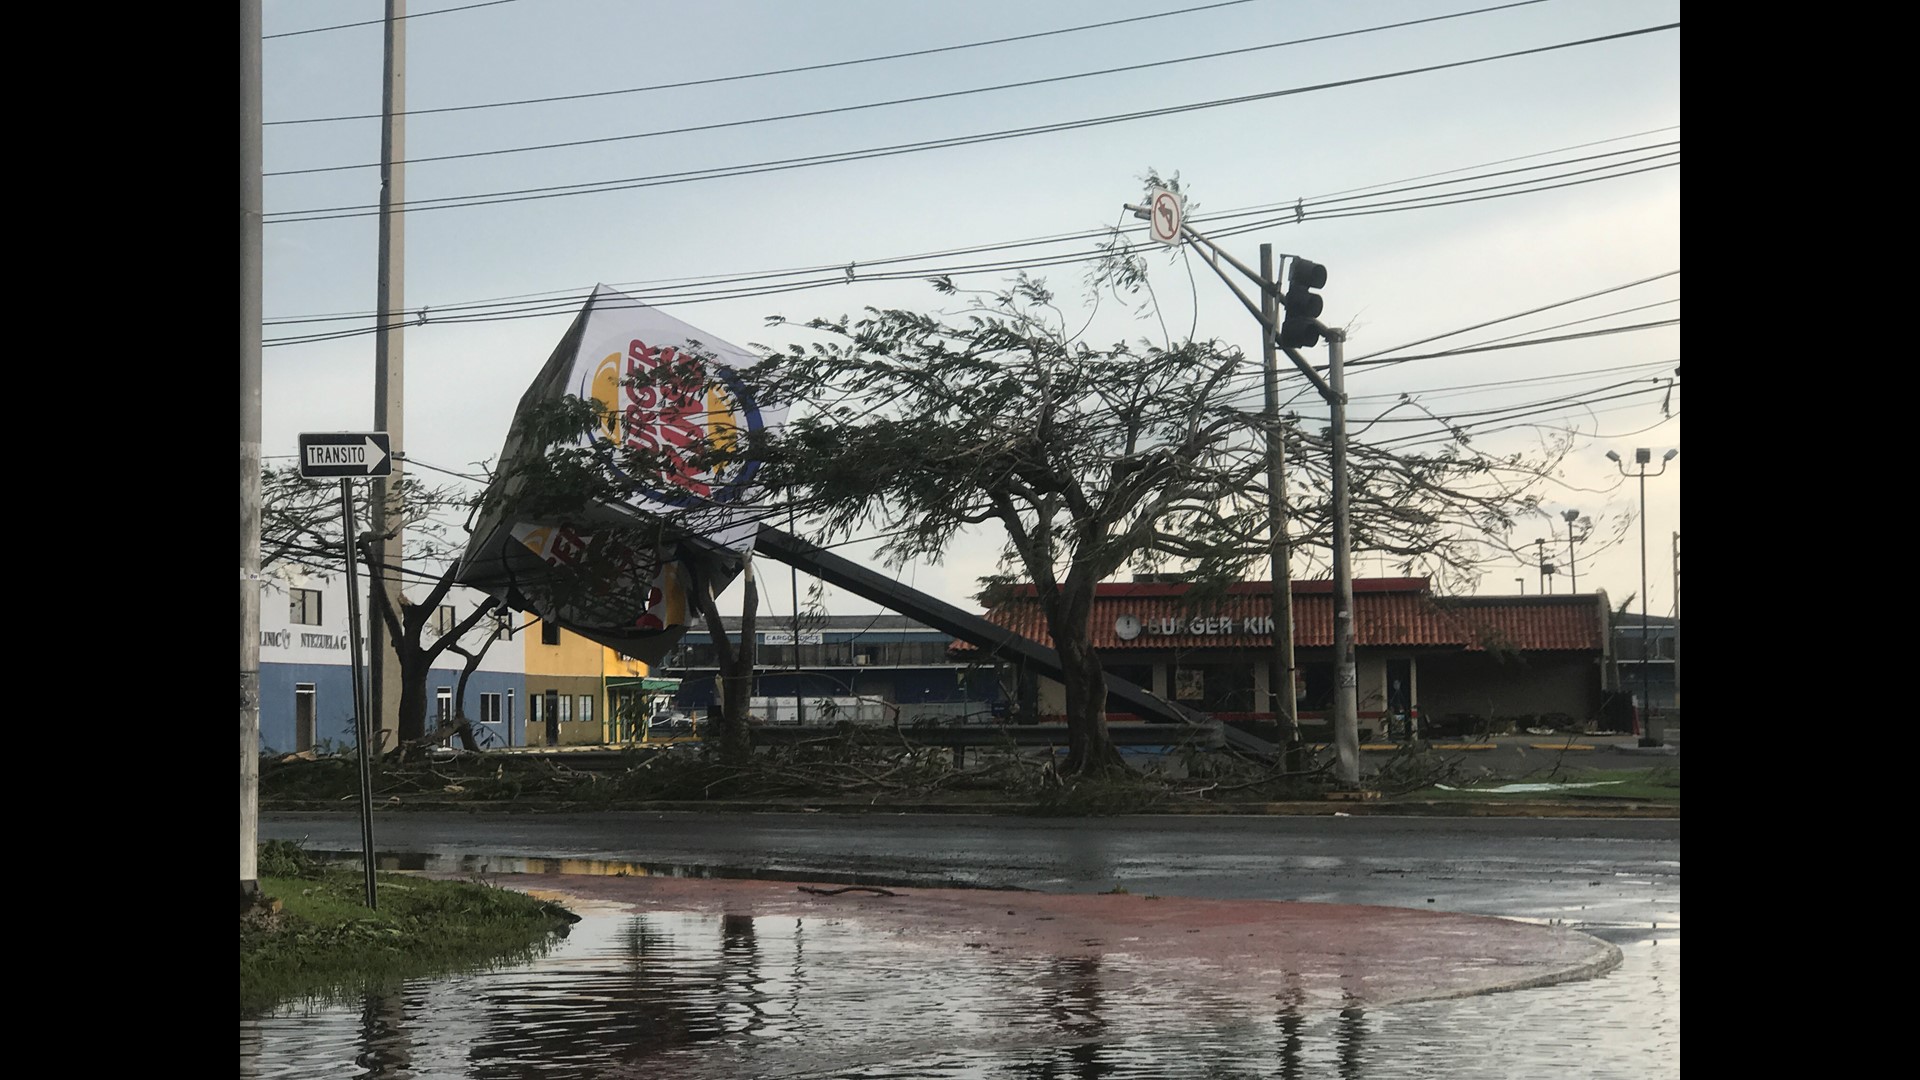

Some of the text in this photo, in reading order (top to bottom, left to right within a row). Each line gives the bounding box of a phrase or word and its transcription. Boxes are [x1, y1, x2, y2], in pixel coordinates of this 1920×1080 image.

[626, 339, 660, 477] URGER
[309, 447, 365, 464] TRANSITO
[1243, 616, 1295, 635] KIN
